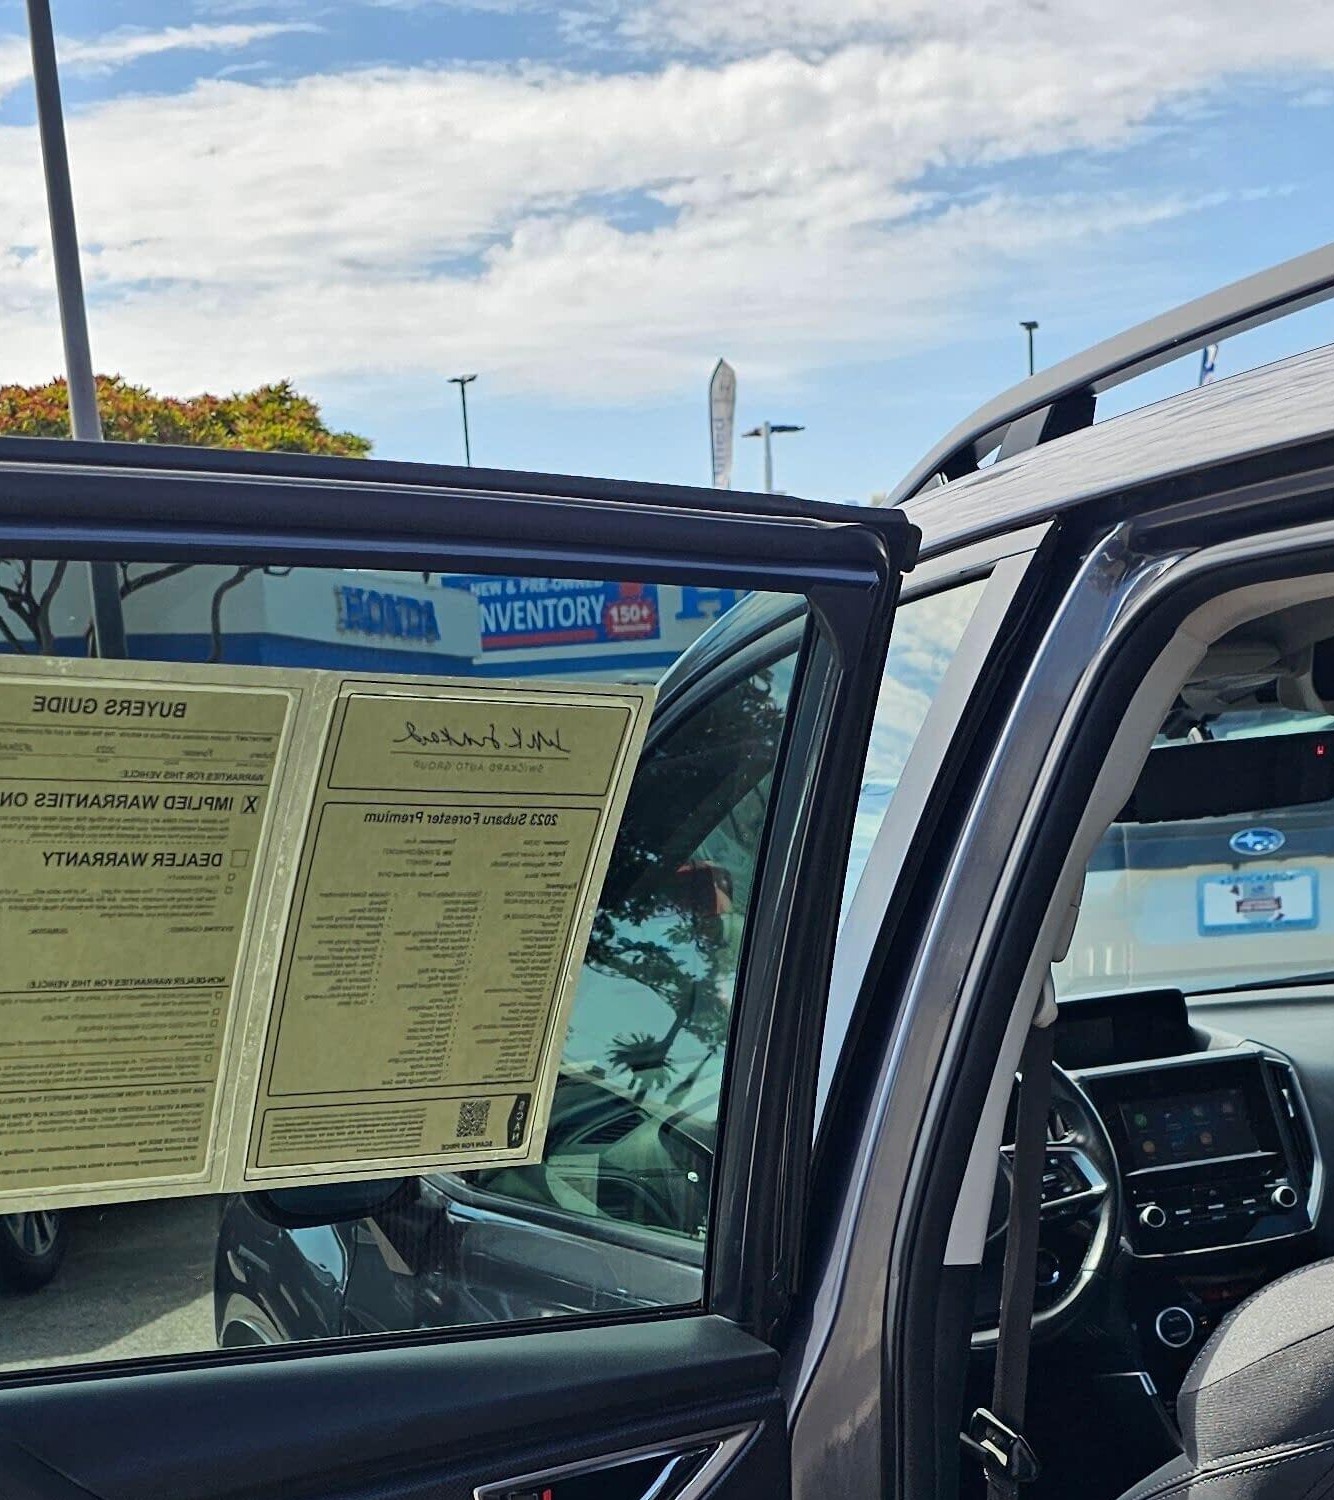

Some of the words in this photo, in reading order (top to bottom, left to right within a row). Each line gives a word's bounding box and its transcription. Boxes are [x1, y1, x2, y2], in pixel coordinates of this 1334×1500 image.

[338, 586, 441, 641] HONDA
[480, 595, 605, 633] NVENTORY
[609, 603, 650, 624] 150+
